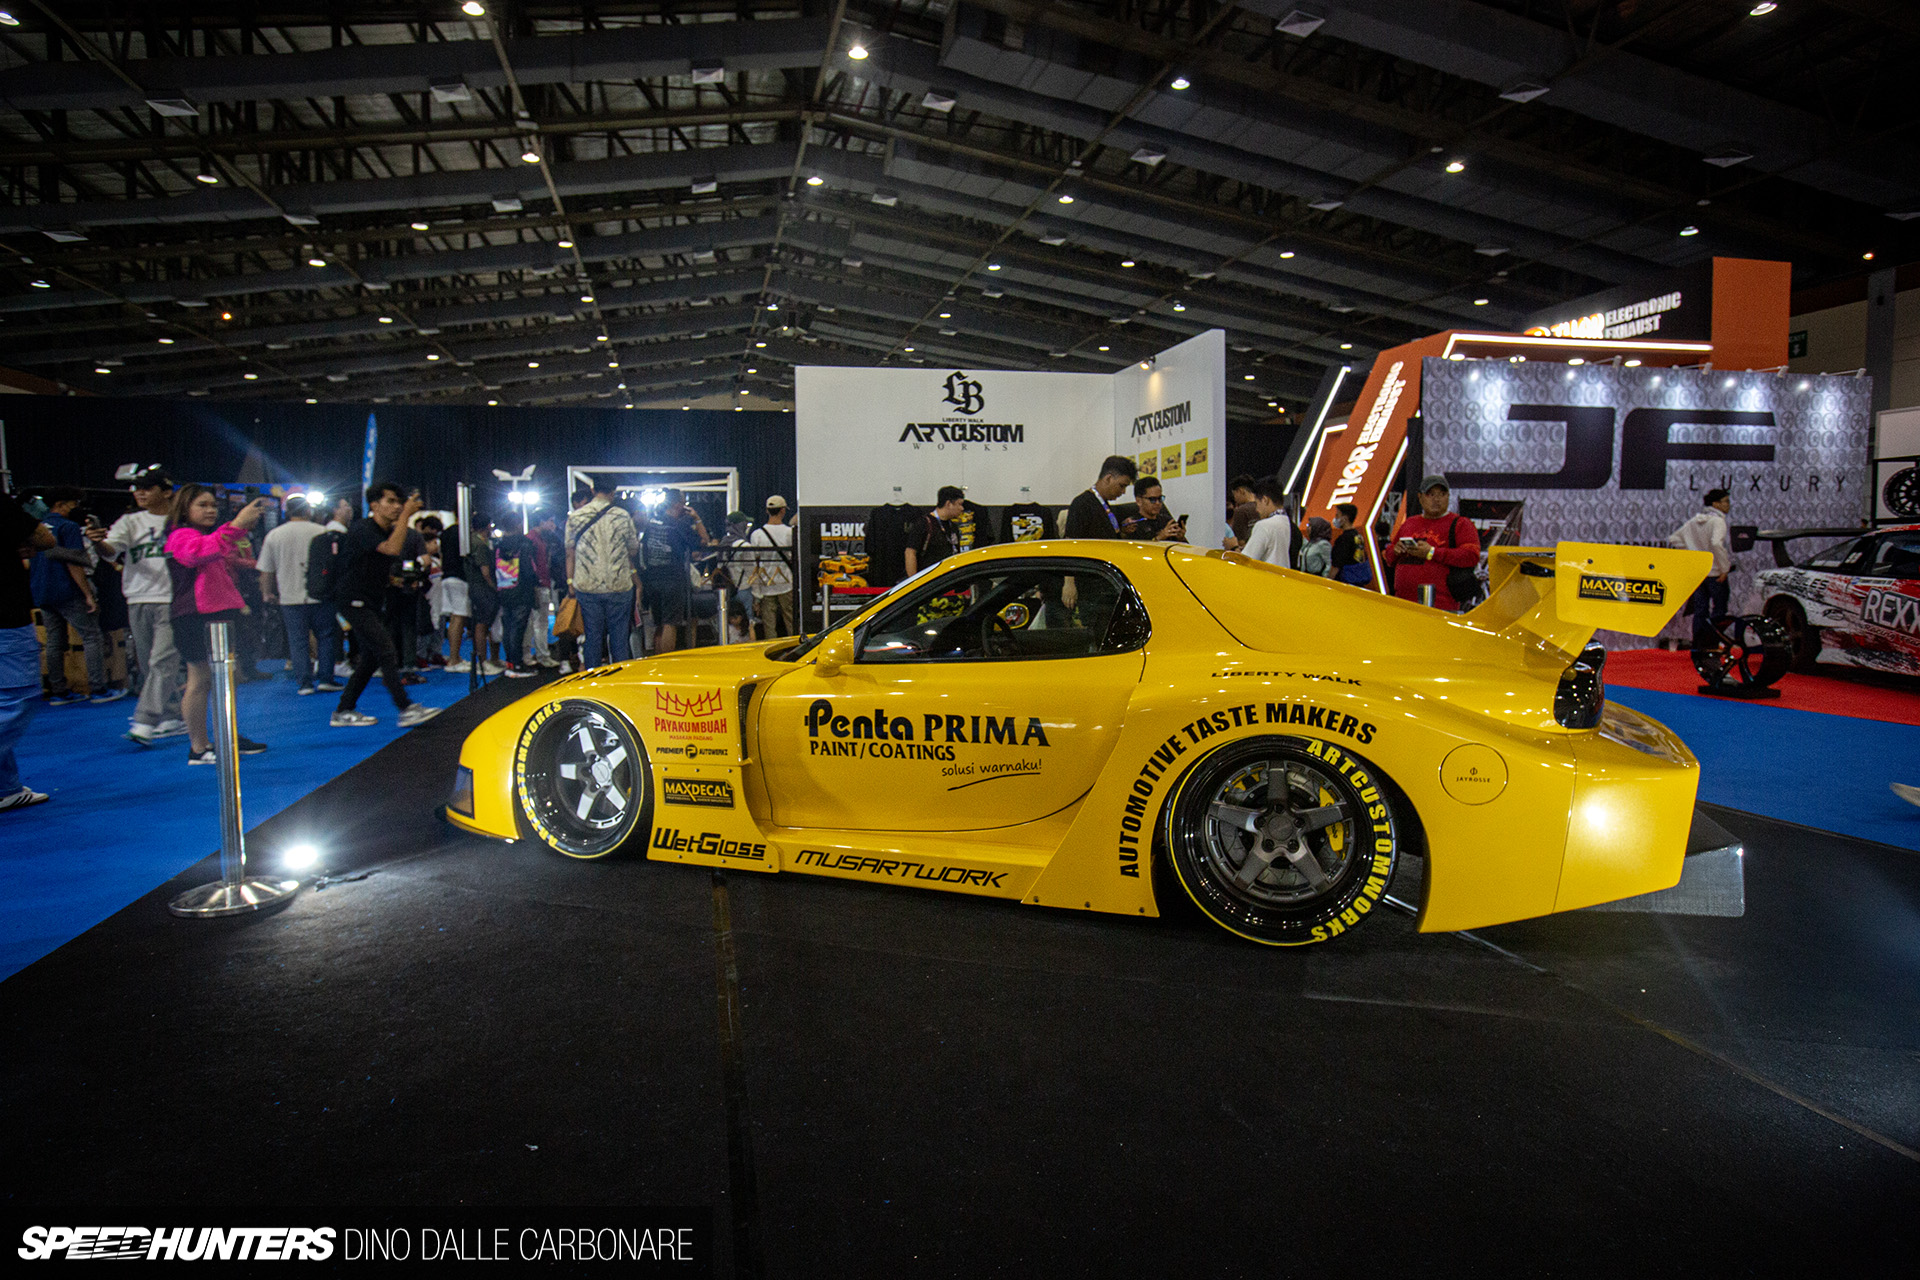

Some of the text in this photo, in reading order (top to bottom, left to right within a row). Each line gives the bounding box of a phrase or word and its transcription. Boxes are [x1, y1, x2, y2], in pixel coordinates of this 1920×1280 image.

[1605, 291, 1682, 327] ELECTRONIC
[1326, 443, 1378, 510] THOR
[1690, 475, 1846, 494] LUXURY
[821, 523, 866, 537] LBWK
[1582, 579, 1661, 598] MAXDECAL
[1302, 673, 1363, 687] WALK
[654, 717, 727, 734] PAYAKUMBUAH
[804, 699, 1051, 747] Penta PRIMA
[656, 747, 684, 755] PREMIER
[941, 758, 1042, 776] solusi warnaku!
[665, 782, 730, 802] MAXDECAL
[1119, 703, 1377, 878] AUTOMOTIVE TASTE MAKERS
[1306, 739, 1394, 942] ARTCUSTOMWORKS
[795, 850, 1008, 888] MUSARTWORK
